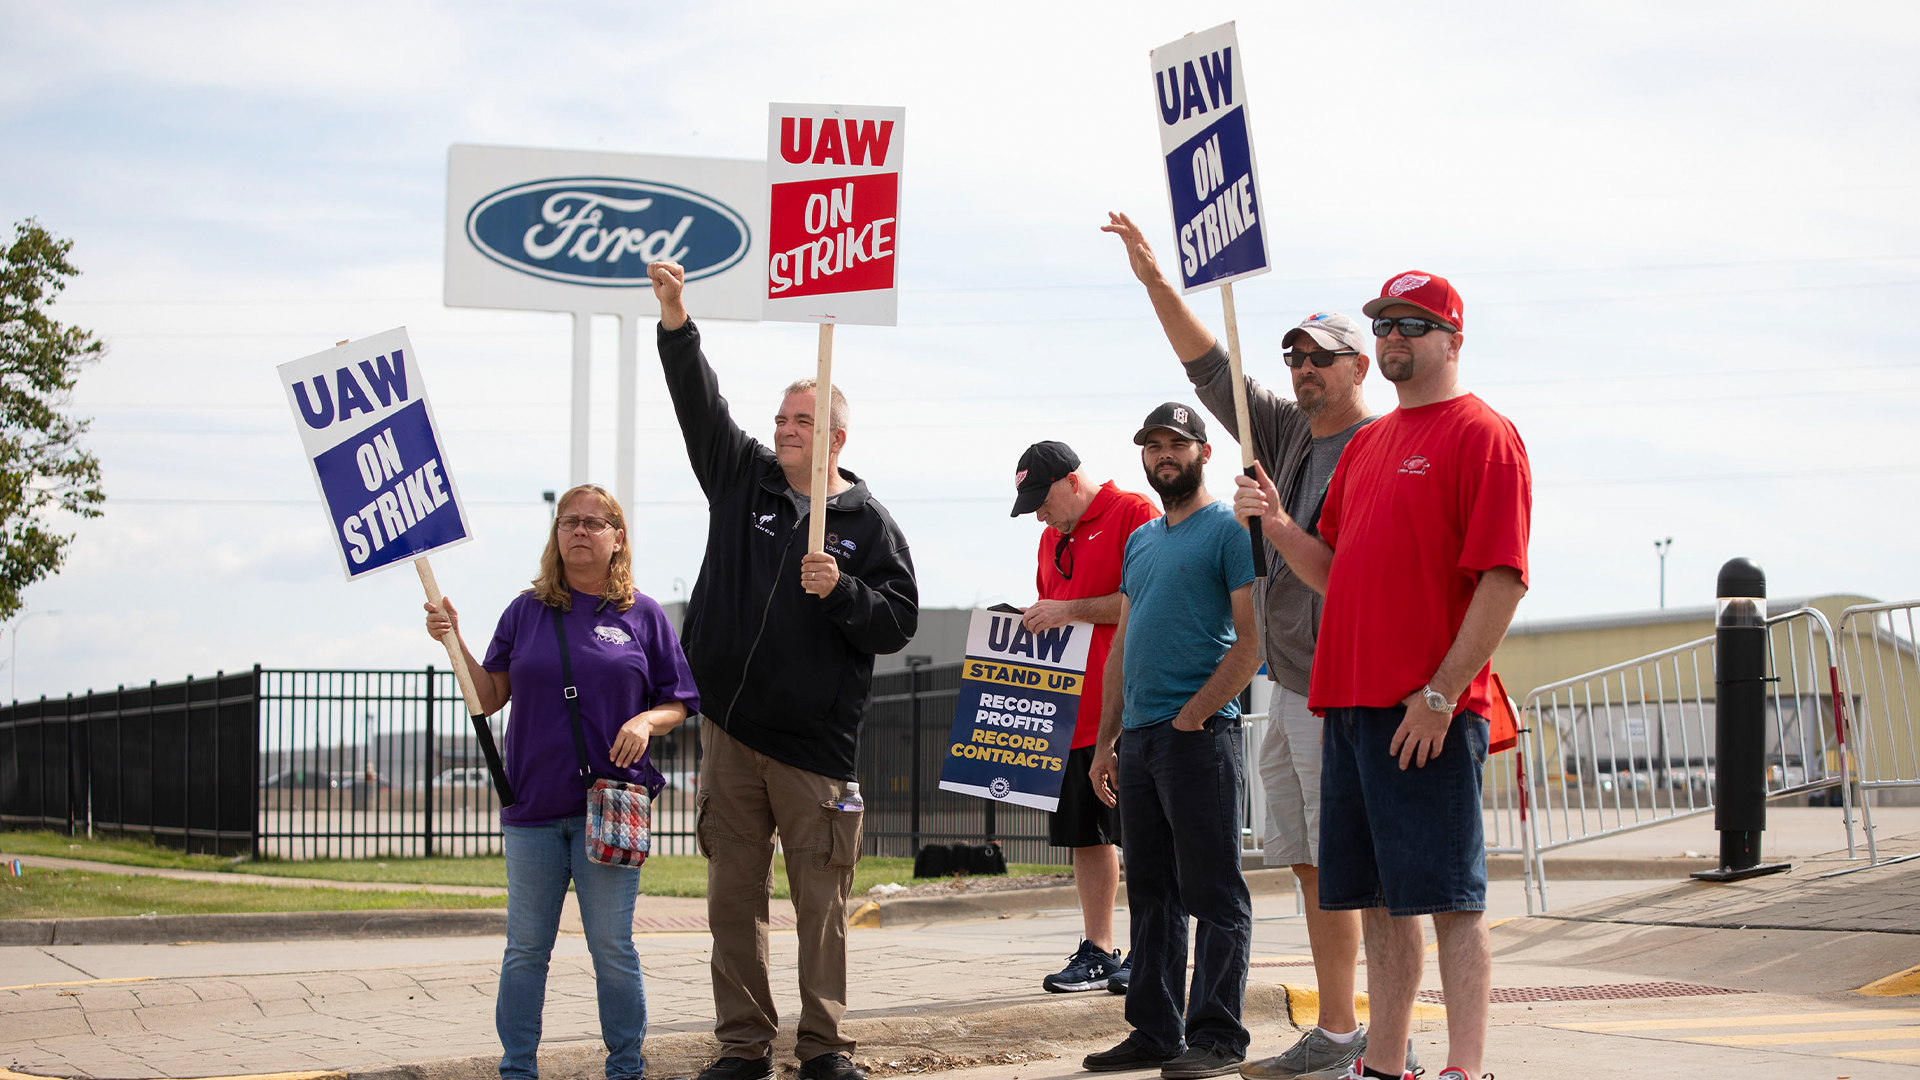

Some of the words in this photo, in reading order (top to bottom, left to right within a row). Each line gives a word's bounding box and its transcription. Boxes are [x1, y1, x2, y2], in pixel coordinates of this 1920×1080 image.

[1155, 46, 1233, 126] UAW
[780, 117, 895, 167] UAW
[1192, 132, 1224, 202] ON
[523, 191, 695, 264] Ford
[804, 182, 854, 234] ON
[1180, 172, 1256, 278] STRIKE
[769, 217, 896, 294] STRIKE
[291, 349, 409, 430] UAW
[356, 427, 404, 492] ON
[342, 457, 450, 565] STRIKE
[825, 544, 842, 555] LOCAL
[988, 616, 1075, 664] UAW
[969, 663, 1041, 686] STAND
[1047, 674, 1076, 691] UP
[975, 709, 1054, 733] PROFITS
[979, 692, 1057, 716] RECORD
[951, 743, 1062, 772] CONTRACTS
[971, 728, 1049, 752] RECORD
